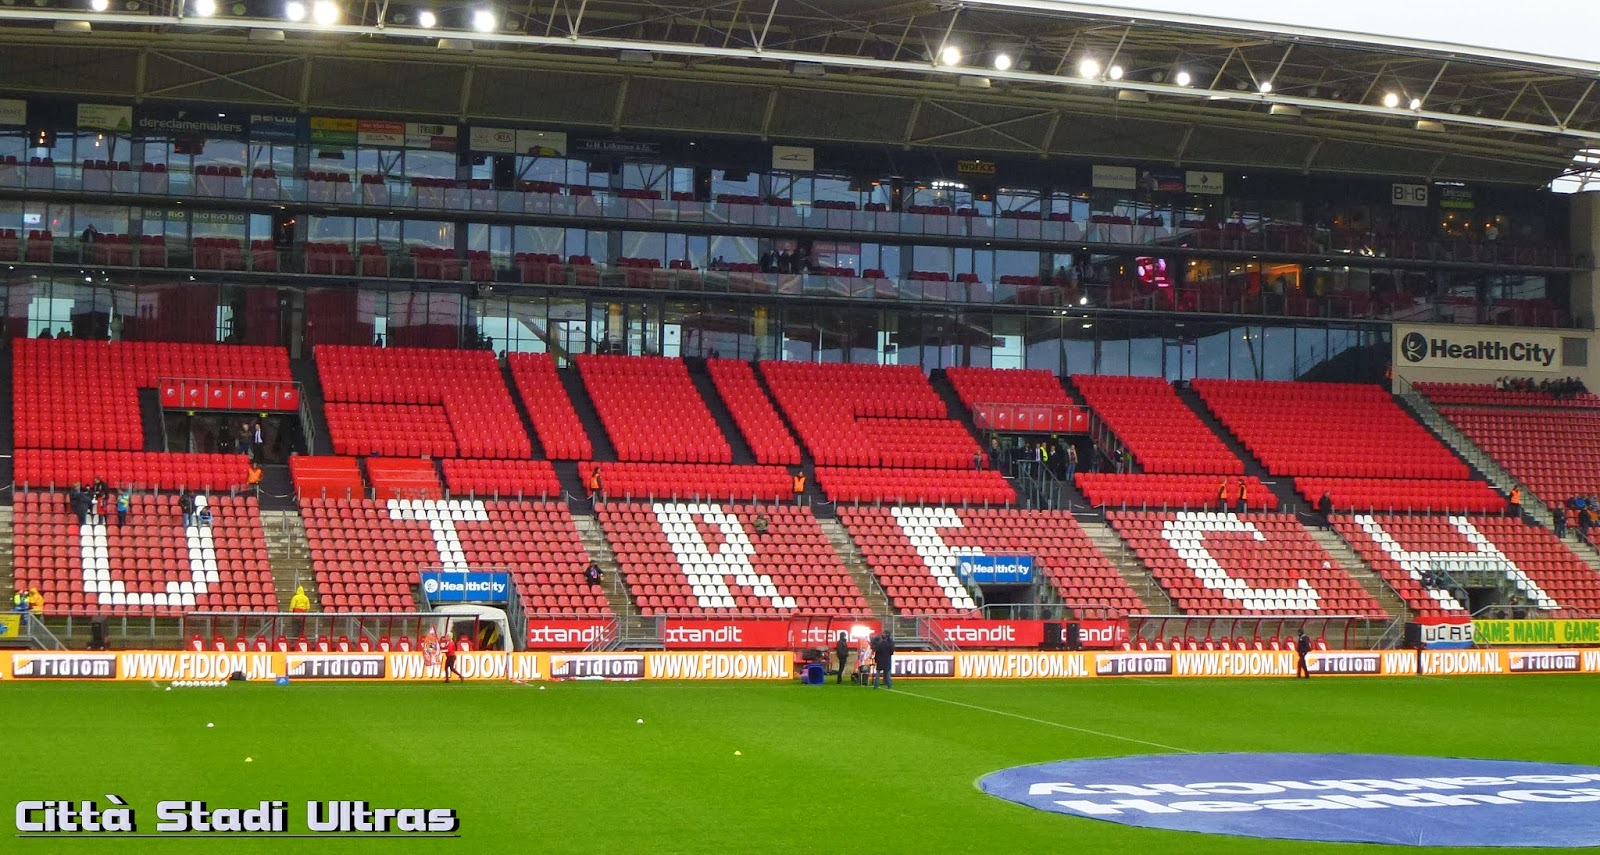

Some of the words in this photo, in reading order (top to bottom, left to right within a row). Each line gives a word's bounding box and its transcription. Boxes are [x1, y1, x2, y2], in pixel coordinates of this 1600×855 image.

[139, 116, 243, 133] dereclamemakers
[1393, 186, 1426, 201] BHG
[1430, 338, 1556, 367] HealthCity
[973, 564, 1030, 575] HealthCity
[440, 581, 506, 593] HealthCity
[530, 626, 609, 642] xtandit
[666, 625, 742, 642] xtandit
[944, 625, 1015, 642] xtandit
[1473, 621, 1510, 642] GAME
[1513, 621, 1556, 642] MANIA
[1563, 620, 1600, 642] GAME
[39, 658, 110, 676] Fidiom
[122, 653, 277, 679] WWW.FIDIOM.NL
[312, 659, 379, 676] Fidiom
[575, 659, 639, 676] Fidiom
[649, 653, 790, 679] WWW.FIDIOM.NL
[891, 659, 949, 674] Fidiom
[958, 653, 1090, 678] WWW.FIDIOM.NL
[1117, 657, 1167, 673] Fidiom
[1176, 652, 1298, 676] WWW.FIDIOM.NL
[1324, 657, 1376, 672] Fidiom
[1384, 651, 1503, 674] WWW.FIDIOM.NL
[1527, 655, 1576, 670] Fidiom
[1029, 773, 1600, 796] ealthCity
